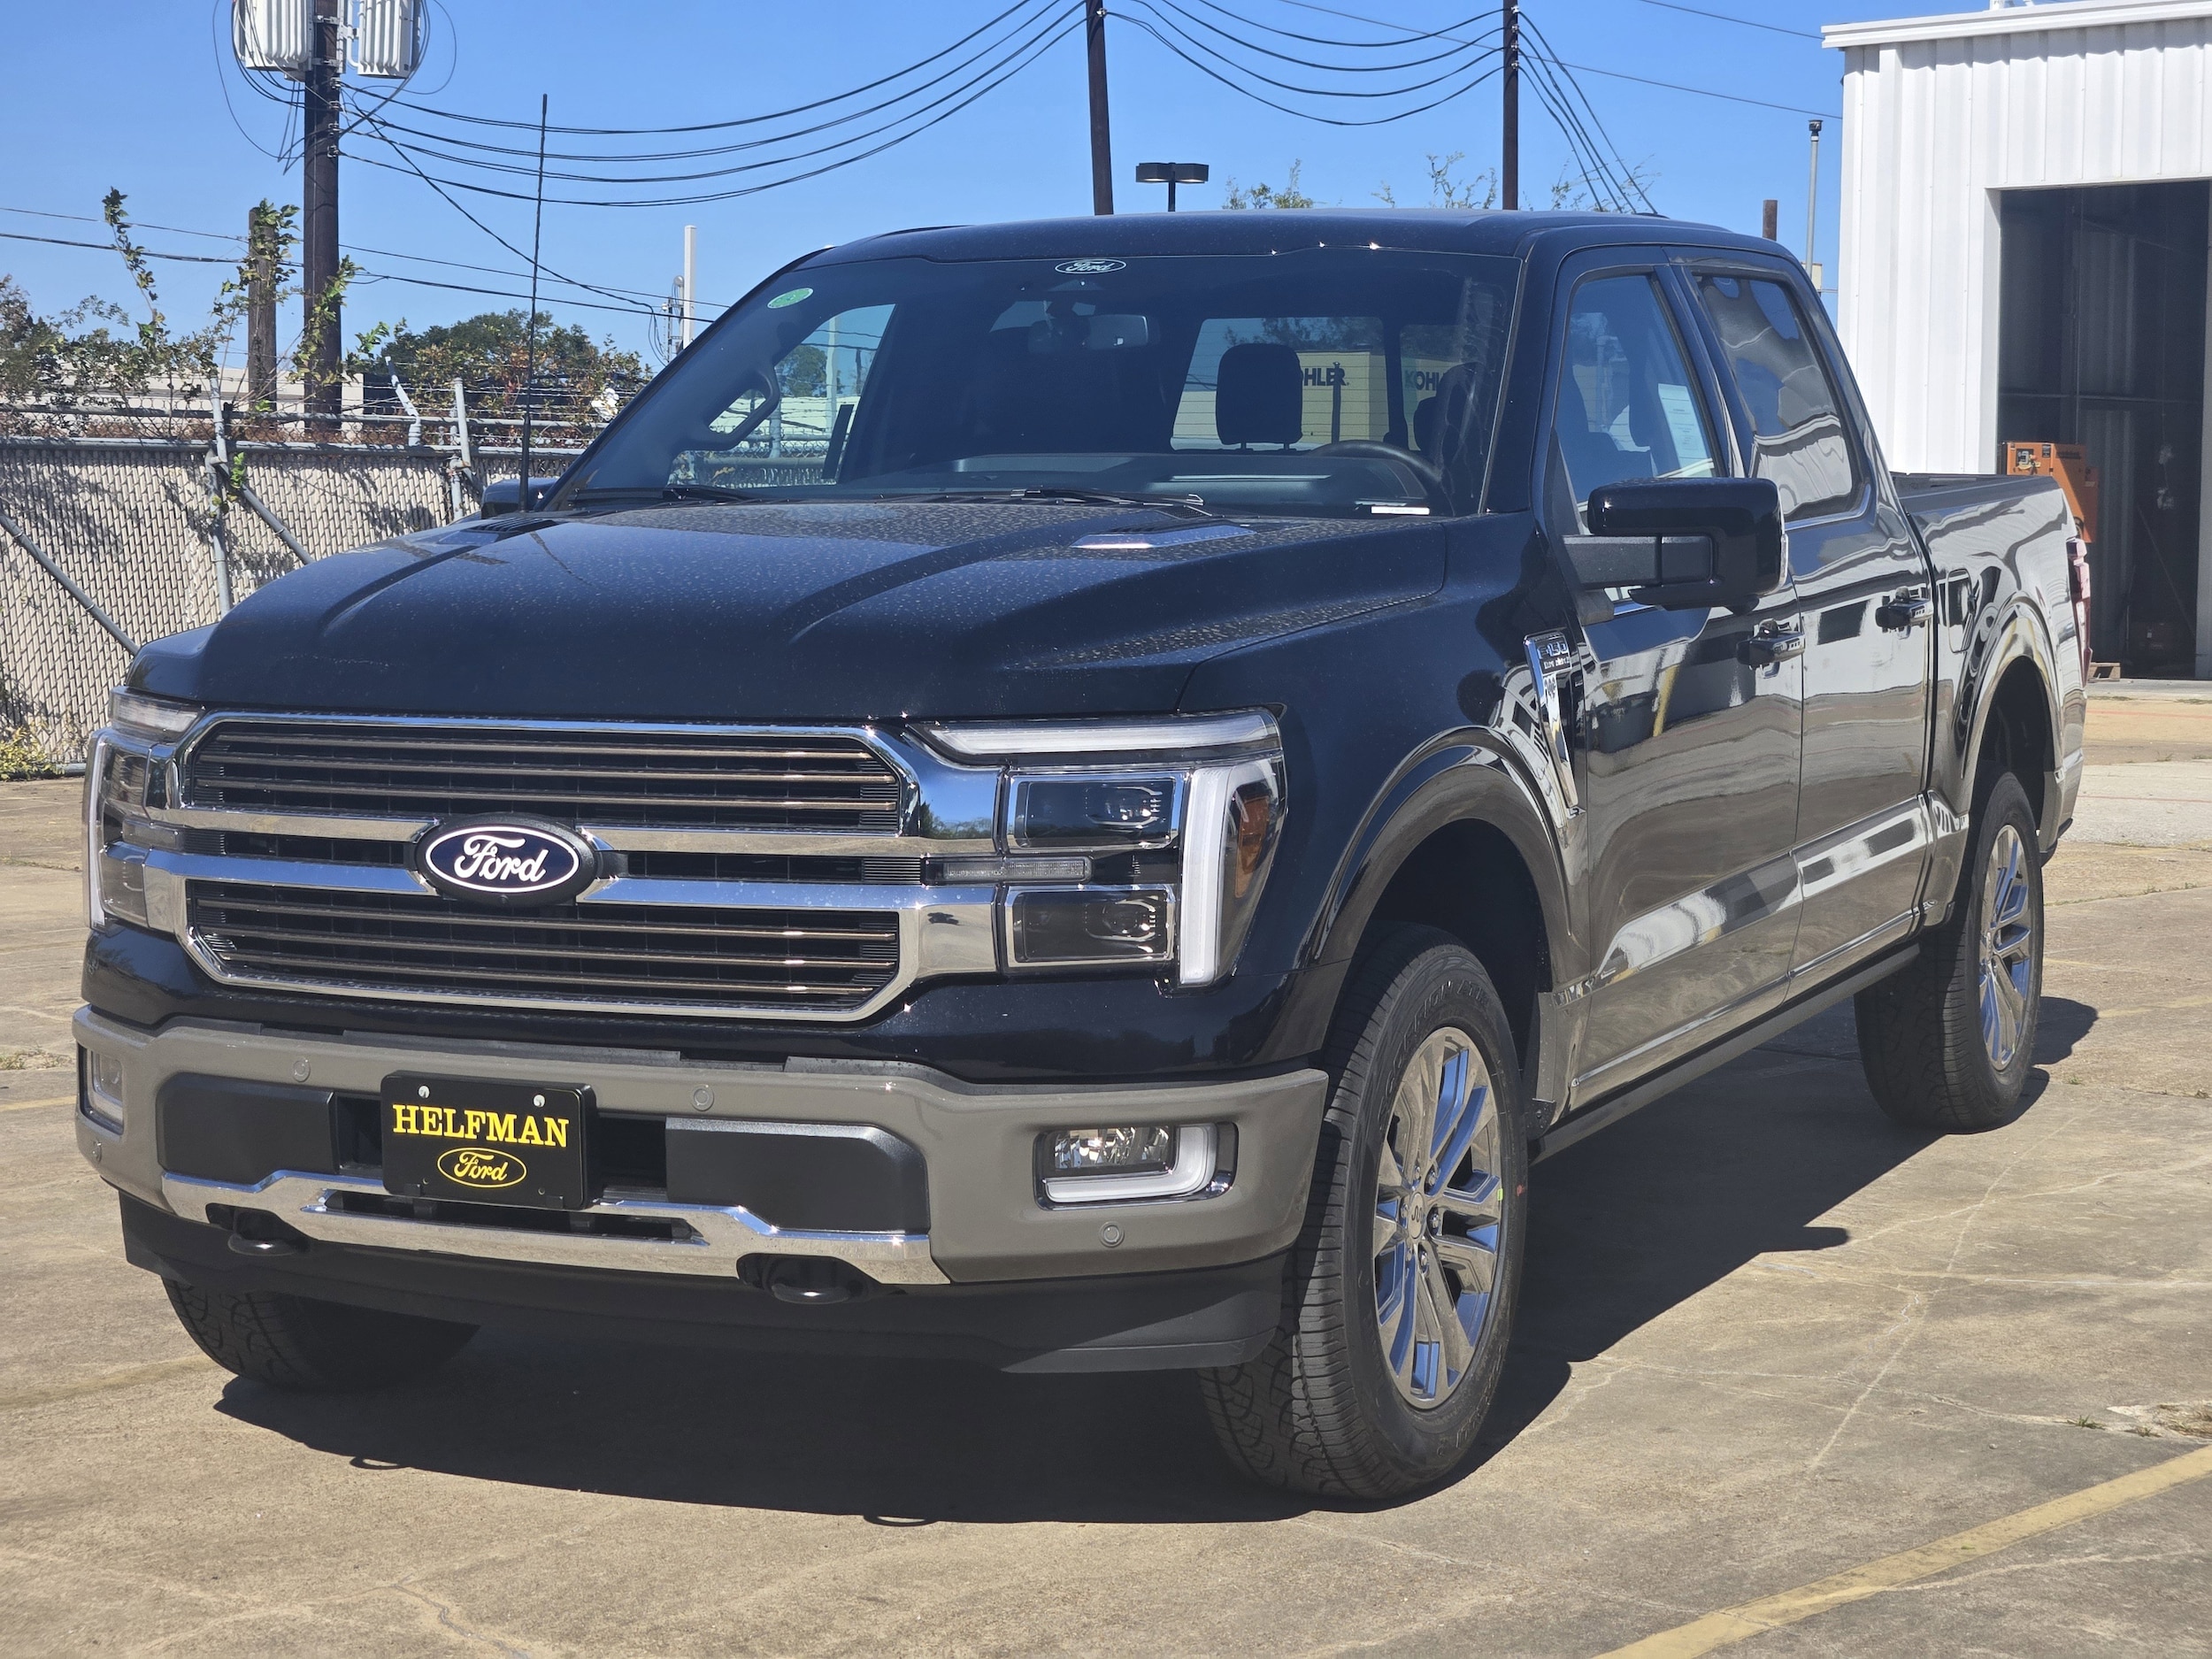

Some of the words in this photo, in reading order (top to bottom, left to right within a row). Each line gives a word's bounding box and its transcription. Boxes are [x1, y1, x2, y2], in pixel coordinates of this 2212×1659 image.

[1065, 260, 1116, 272] Ford
[1303, 367, 1347, 387] HLER
[454, 834, 549, 883] Ford
[392, 1103, 570, 1148] HELFMAN
[453, 1151, 508, 1182] Ford
